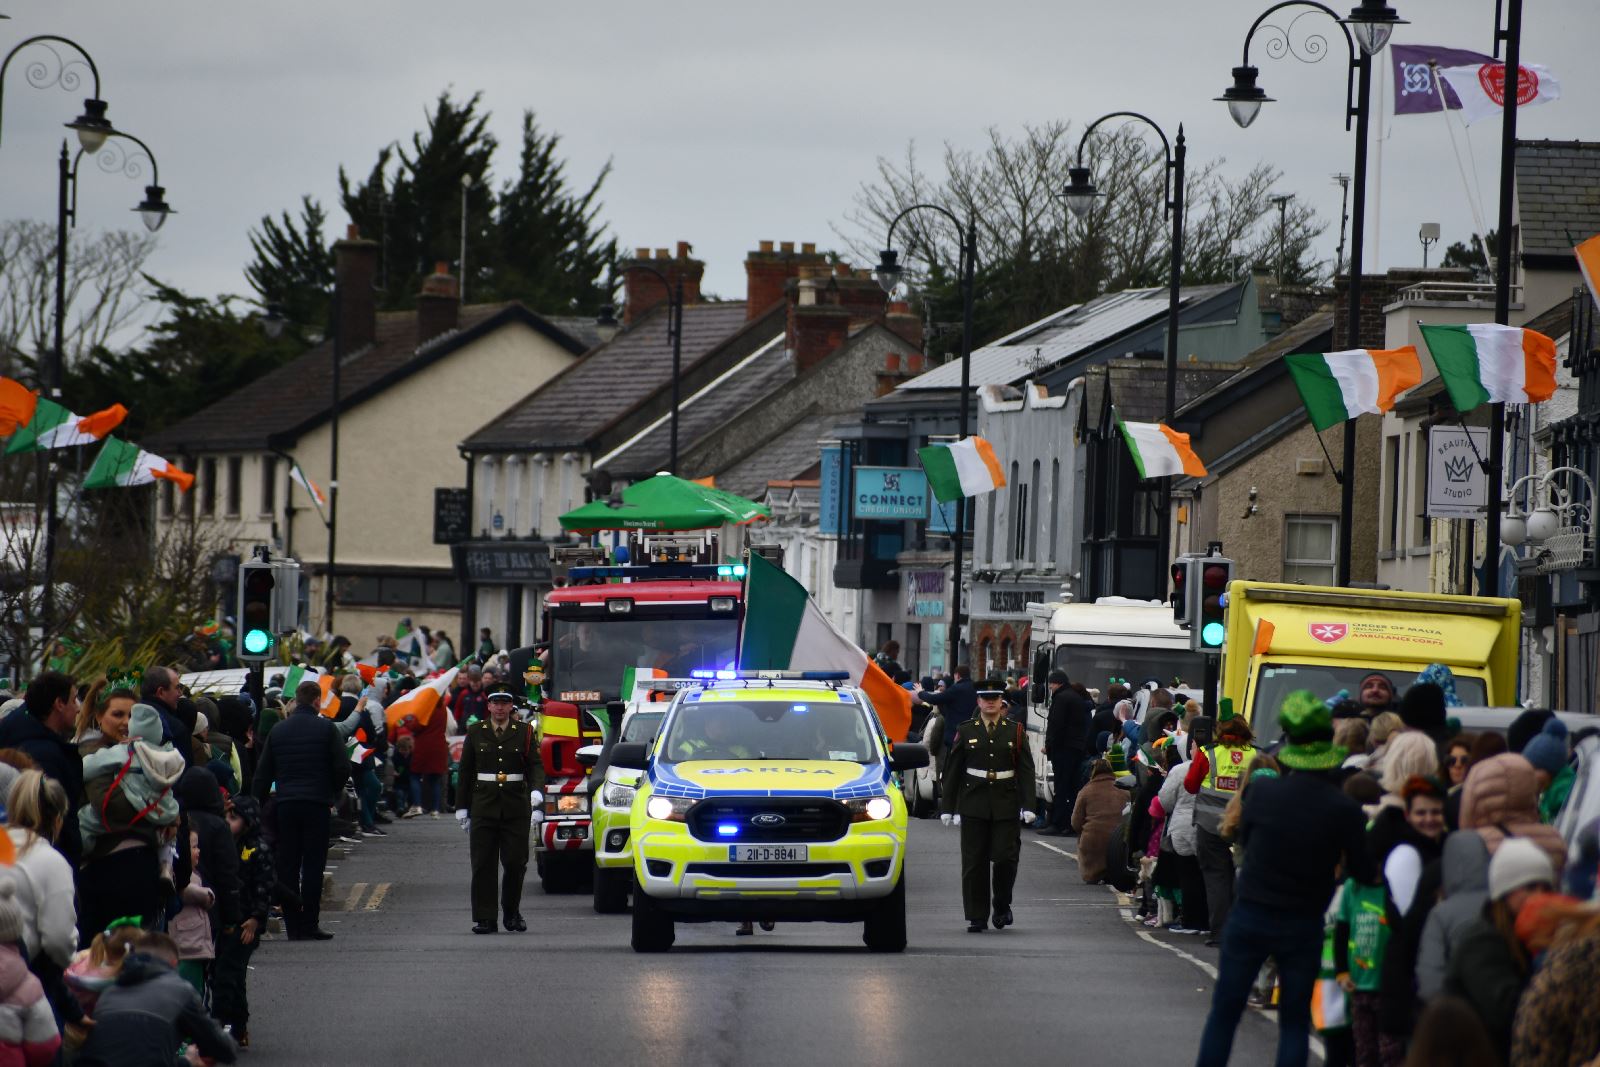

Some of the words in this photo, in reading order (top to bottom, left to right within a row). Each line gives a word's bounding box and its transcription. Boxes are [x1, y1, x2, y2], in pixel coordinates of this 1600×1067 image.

[1443, 487, 1473, 499] STUDIO
[859, 494, 923, 507] CONNECT
[859, 505, 890, 514] CREDIT
[893, 506, 922, 515] UNION
[1407, 627, 1442, 635] MALTA
[1352, 633, 1411, 642] AMBULANCE
[701, 767, 835, 775] GARDA
[746, 848, 797, 861] 211-D-8841
